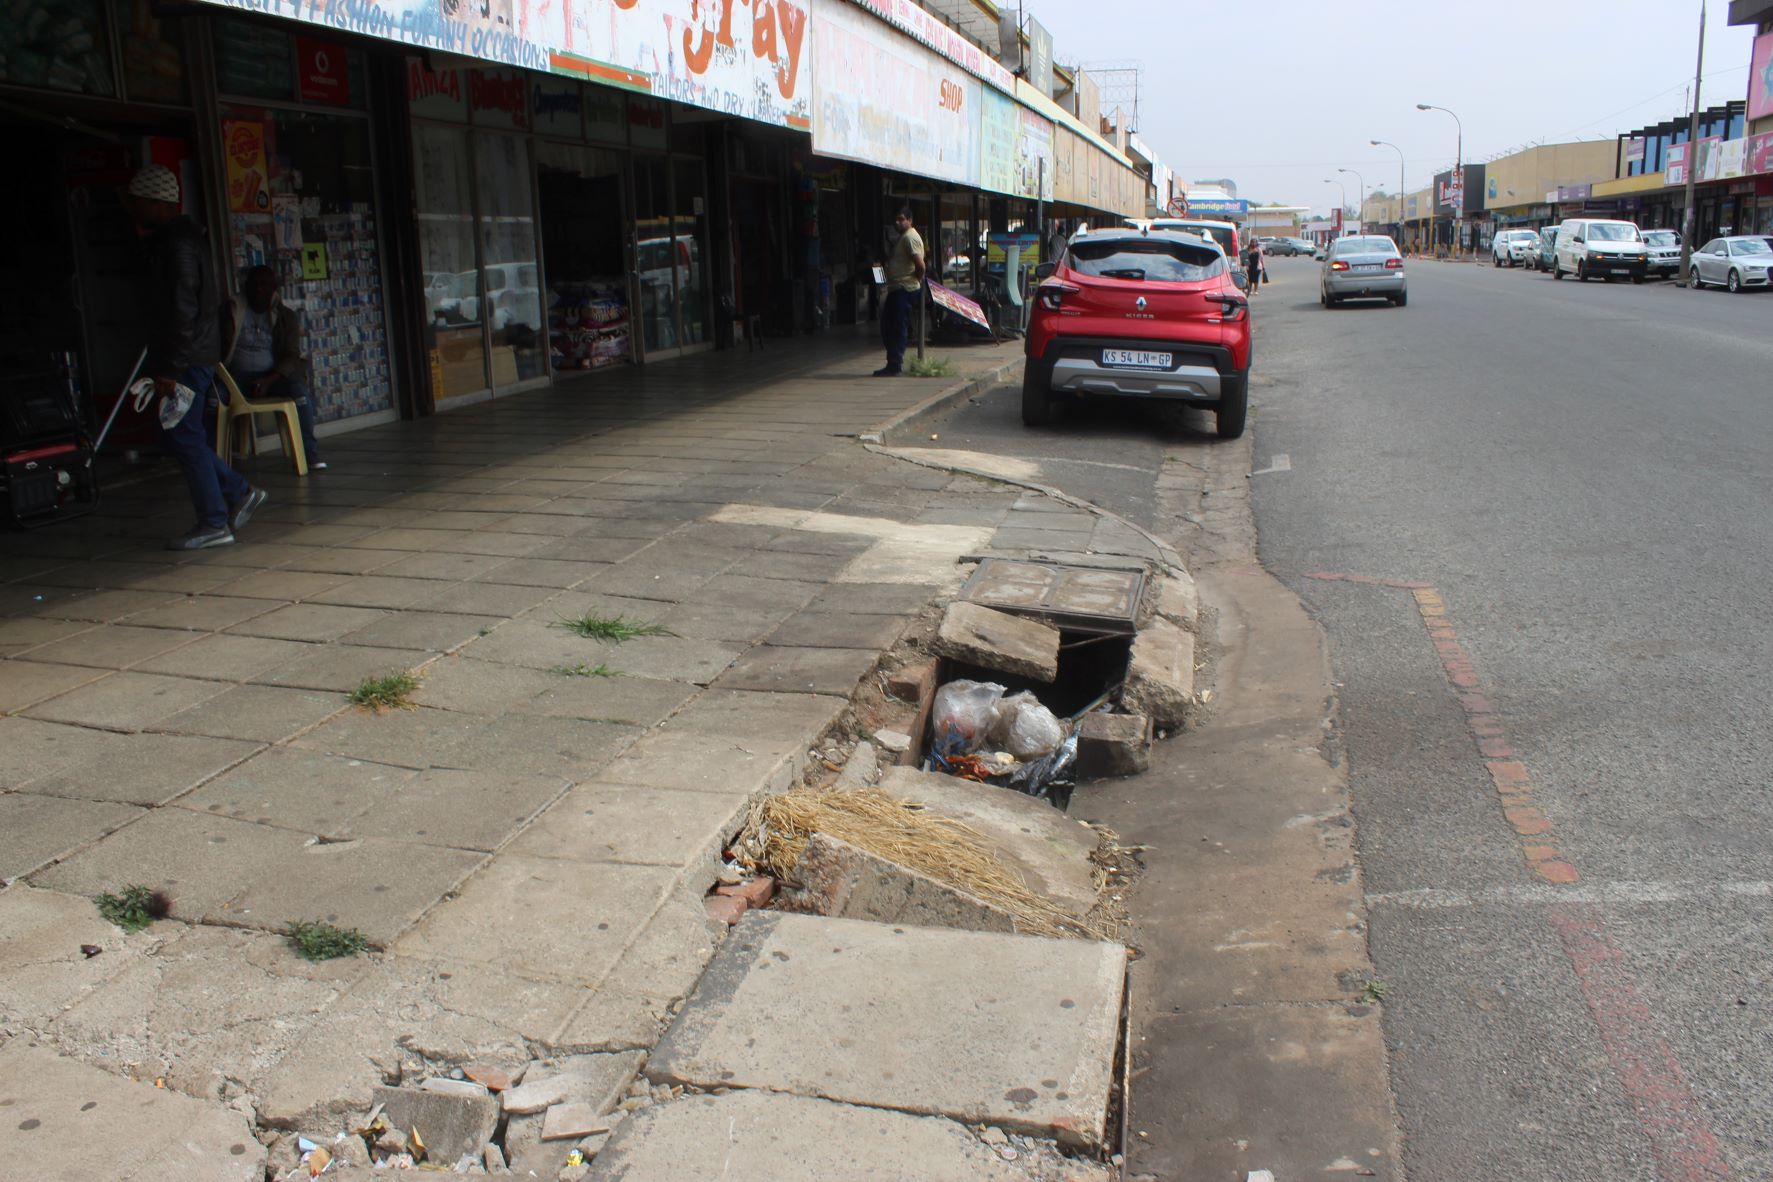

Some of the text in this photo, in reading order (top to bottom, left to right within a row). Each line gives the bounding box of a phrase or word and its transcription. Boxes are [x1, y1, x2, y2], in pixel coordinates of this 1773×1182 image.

[400, 10, 432, 46] FOR
[435, 18, 468, 54] ANY
[471, 25, 549, 70] OCCASIONS
[651, 71, 697, 105] TAILORS
[701, 83, 719, 110] AND
[723, 90, 745, 117] DRY
[938, 78, 963, 114] SHOP
[1104, 351, 1171, 365] KS 54 LN GP
